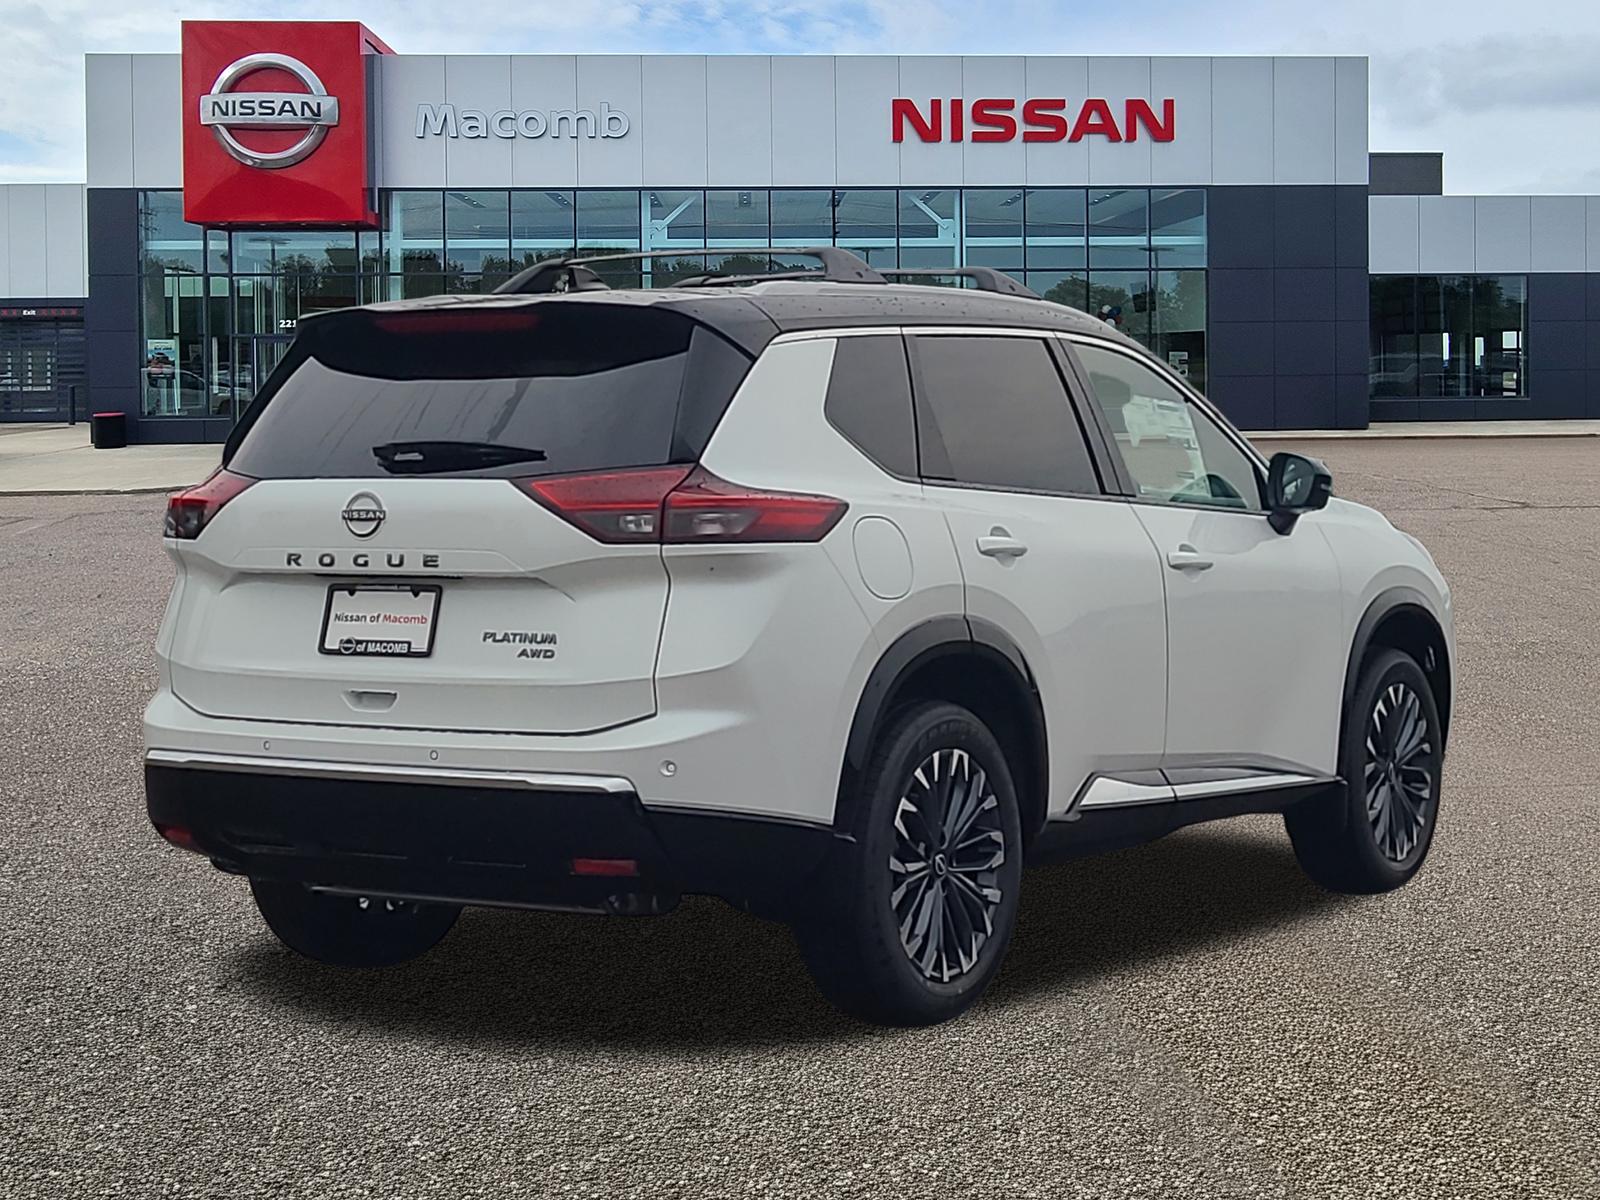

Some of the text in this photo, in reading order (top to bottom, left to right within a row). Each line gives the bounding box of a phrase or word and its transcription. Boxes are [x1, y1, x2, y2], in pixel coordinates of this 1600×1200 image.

[212, 100, 321, 117] NISSAN
[414, 102, 630, 140] Macomb
[892, 98, 1175, 143] NISSAN
[342, 510, 385, 520] NISSAN
[286, 553, 439, 568] ROGUE
[334, 612, 428, 625] Nissan of Macomb
[482, 631, 558, 645] PLATINUM
[356, 642, 408, 653] of MACOMB
[517, 648, 555, 659] AWD
